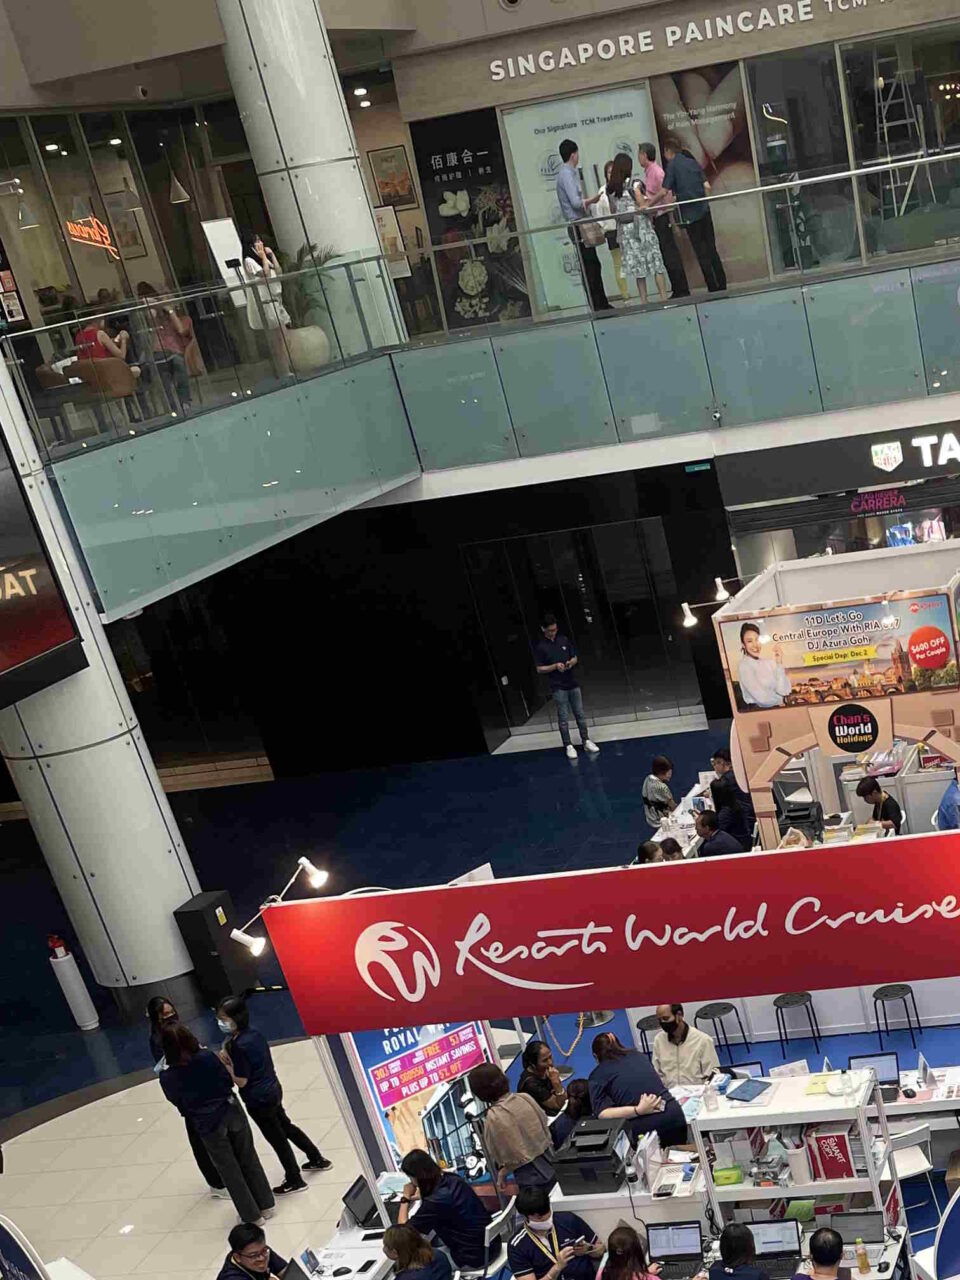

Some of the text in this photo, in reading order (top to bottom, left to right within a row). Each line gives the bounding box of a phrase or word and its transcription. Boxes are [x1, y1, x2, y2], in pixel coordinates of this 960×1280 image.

[489, 31, 655, 81] SINGAPORE
[666, 1, 815, 47] PAINCARE
[547, 121, 578, 134] Signature
[580, 115, 596, 127] TCM
[597, 110, 634, 124] Treatments
[430, 148, 490, 170] 佰康合一
[851, 495, 906, 512] CARRERA
[805, 611, 864, 625] 11D Let's Go
[772, 628, 805, 643] Central
[807, 627, 840, 642] Europe
[841, 622, 863, 635] With
[864, 621, 881, 633] RIA
[807, 640, 820, 651] DJ
[822, 637, 848, 649] Azura
[930, 636, 945, 647] OFF
[812, 652, 834, 663] Special
[850, 650, 862, 658] Dec
[833, 713, 871, 726] Chan's
[835, 724, 873, 737] World
[836, 733, 873, 746] Holidays
[455, 911, 614, 992] Resorts
[625, 902, 769, 955] World
[382, 1029, 421, 1055] ROYAL
[380, 1081, 389, 1093] UP
[390, 1077, 400, 1088] TO
[401, 1084, 419, 1097] PLUS
[419, 1079, 429, 1090] UP
[429, 1073, 439, 1085] TO
[450, 1062, 463, 1075] OFF
[820, 1139, 835, 1159] COPY
[827, 1137, 847, 1165] SMART
